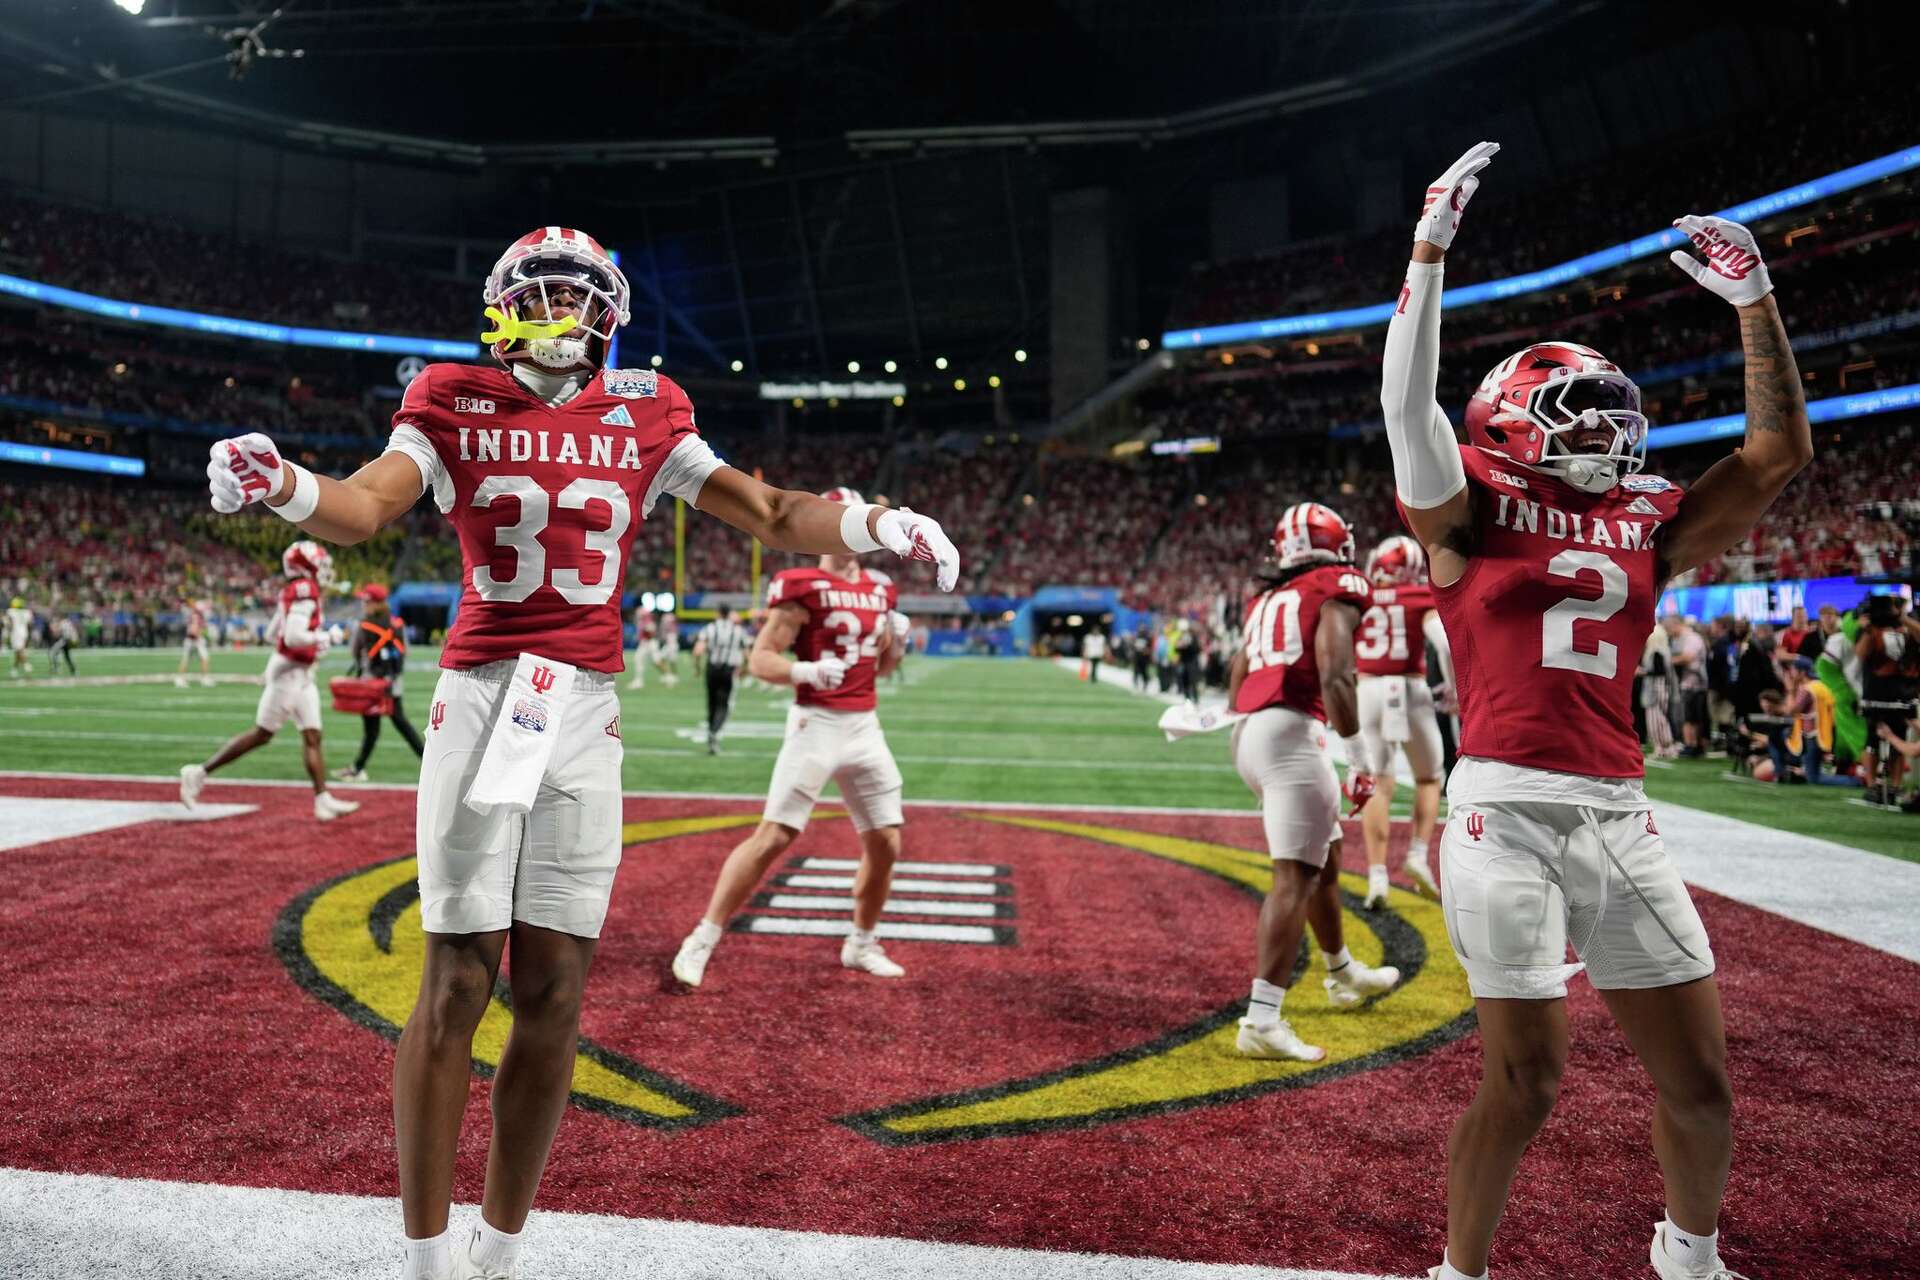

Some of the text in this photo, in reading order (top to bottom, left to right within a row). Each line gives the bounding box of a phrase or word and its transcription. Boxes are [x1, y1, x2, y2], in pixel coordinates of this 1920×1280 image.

[459, 427, 642, 470] INDIANA
[471, 475, 631, 605] 33
[1355, 605, 1409, 660] 31
[1541, 549, 1628, 680] 2
